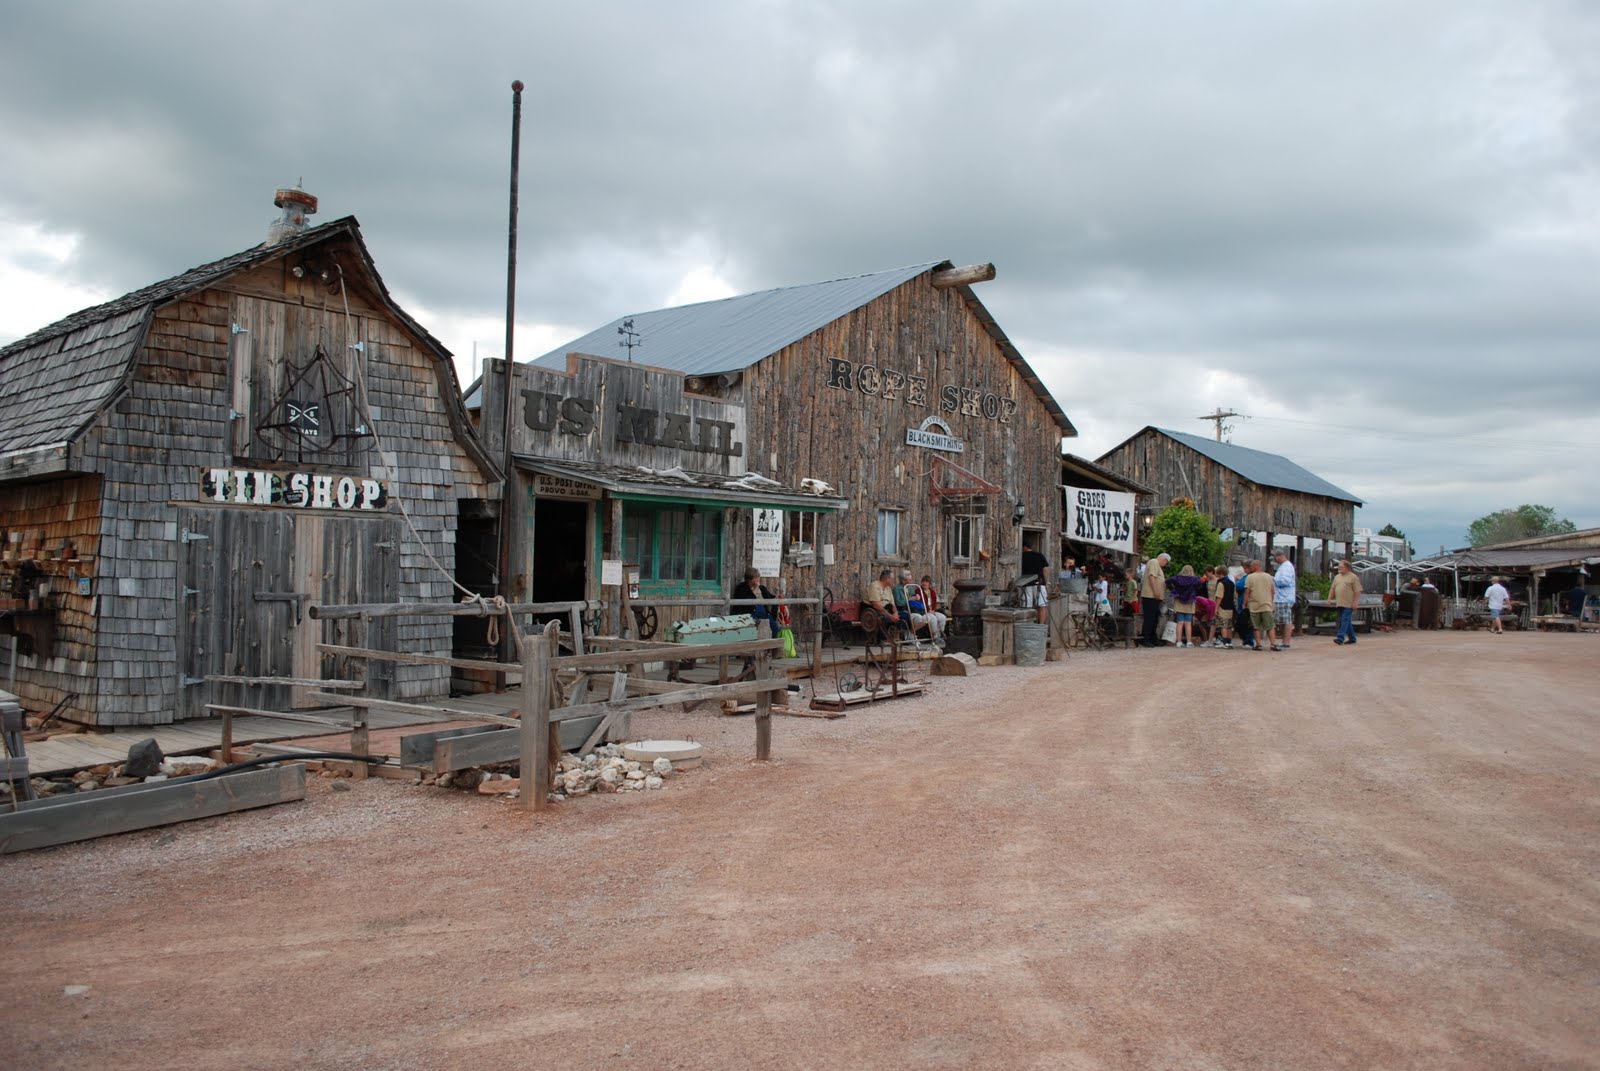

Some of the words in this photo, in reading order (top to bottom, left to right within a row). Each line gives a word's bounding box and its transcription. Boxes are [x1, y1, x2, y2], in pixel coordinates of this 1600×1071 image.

[827, 357, 926, 406] ROPE
[941, 385, 1017, 423] SHOP
[521, 389, 595, 437] US
[617, 404, 743, 457] MAIL
[908, 431, 963, 450] BLACKSMITHING
[210, 468, 273, 505] TIN
[291, 473, 381, 509] SHOP
[540, 476, 553, 486] U.S.
[555, 477, 573, 488] POST
[540, 486, 566, 495] PROVO
[1077, 490, 1106, 509] GREGS
[1075, 505, 1130, 542] KNIVES
